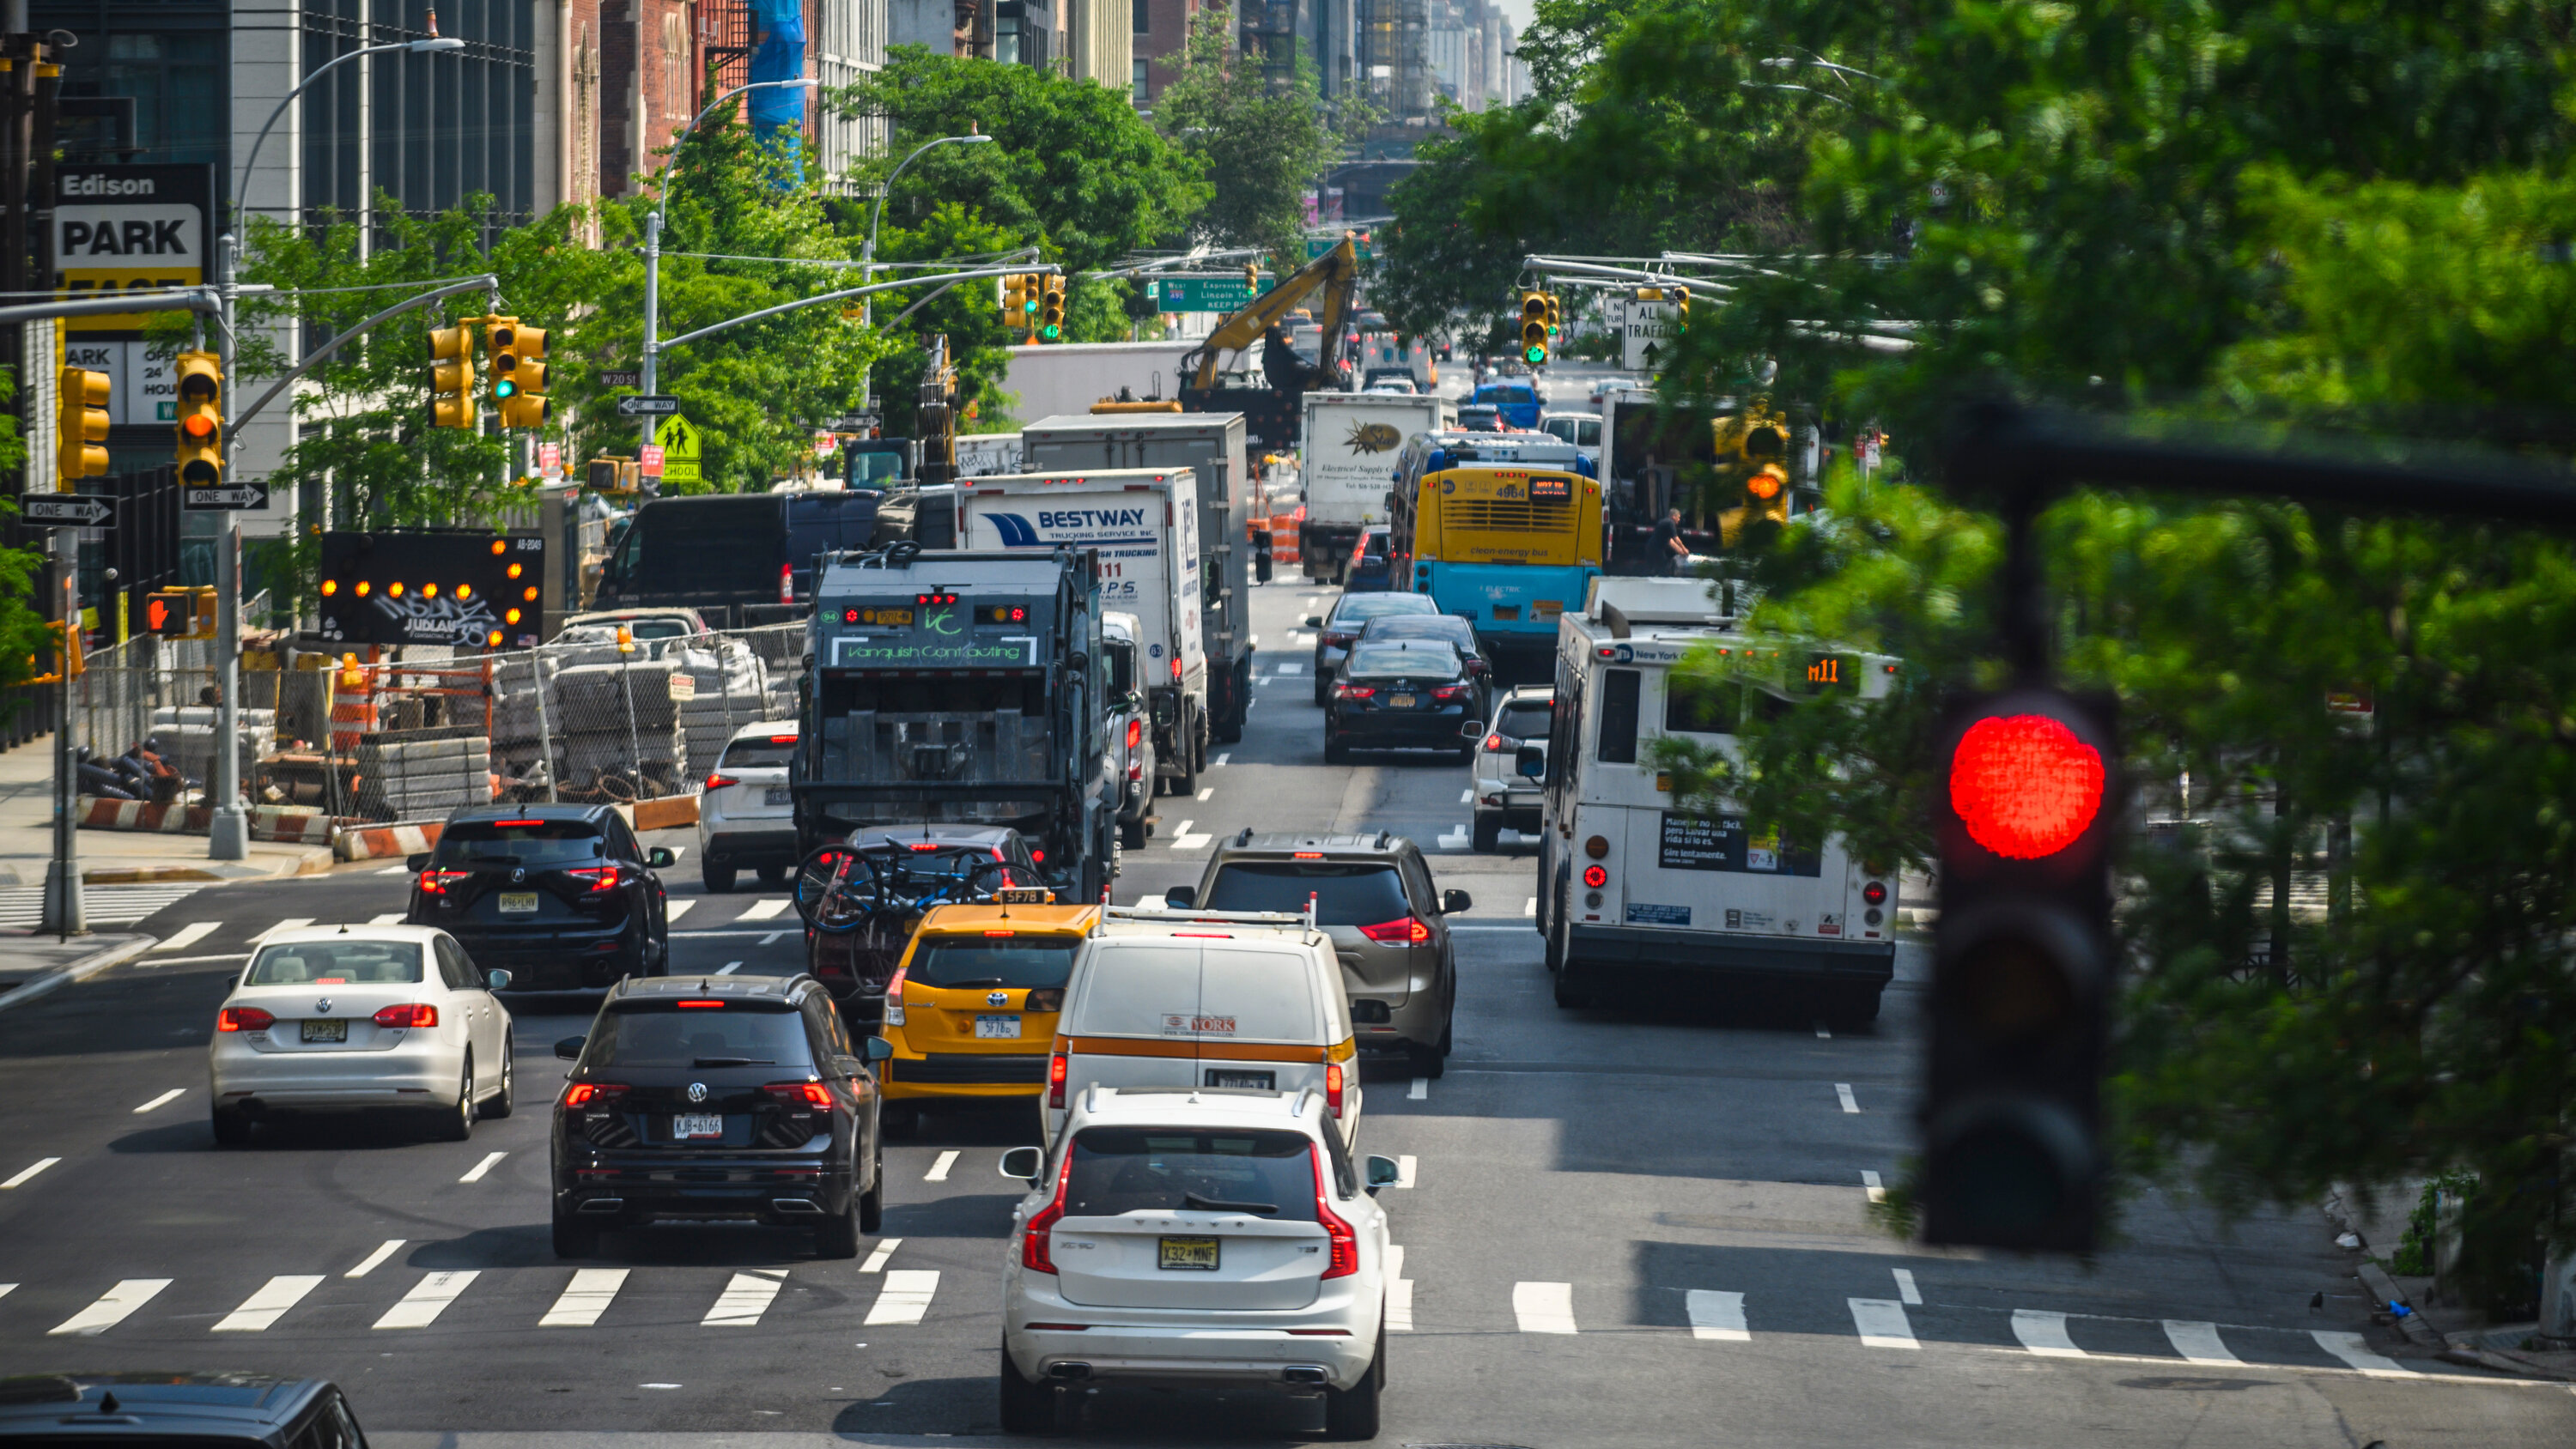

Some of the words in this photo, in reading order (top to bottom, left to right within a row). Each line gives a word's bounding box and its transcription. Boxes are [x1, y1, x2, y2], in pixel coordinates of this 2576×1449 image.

[63, 173, 155, 195] Edison
[63, 219, 188, 256] PARK
[68, 349, 111, 365] ARK
[144, 367, 162, 378] 24
[603, 374, 611, 385] W
[612, 373, 624, 385] 20
[627, 373, 636, 385] St
[627, 400, 645, 409] ONE
[654, 400, 675, 409] WAY
[665, 466, 697, 476] CHOOL
[1358, 464, 1382, 475] Supply
[196, 491, 221, 502] ONE
[231, 489, 257, 501] WAY
[1496, 488, 1525, 498] 4964
[35, 504, 63, 516] ONE
[76, 505, 104, 517] WAY
[1038, 509, 1145, 528] BESTWAY
[1049, 530, 1095, 539] TRUCKING
[1097, 530, 1136, 538] SERVICE
[1115, 549, 1157, 558] TRUCKING
[1532, 548, 1548, 556] bus
[848, 646, 920, 659] Vanquish
[1636, 650, 1656, 659] New
[1658, 651, 1679, 660] York
[1665, 828, 1684, 836] pero
[1664, 848, 1680, 857] Gire
[1007, 891, 1037, 902] 5F78
[1192, 1019, 1235, 1030] YORK
